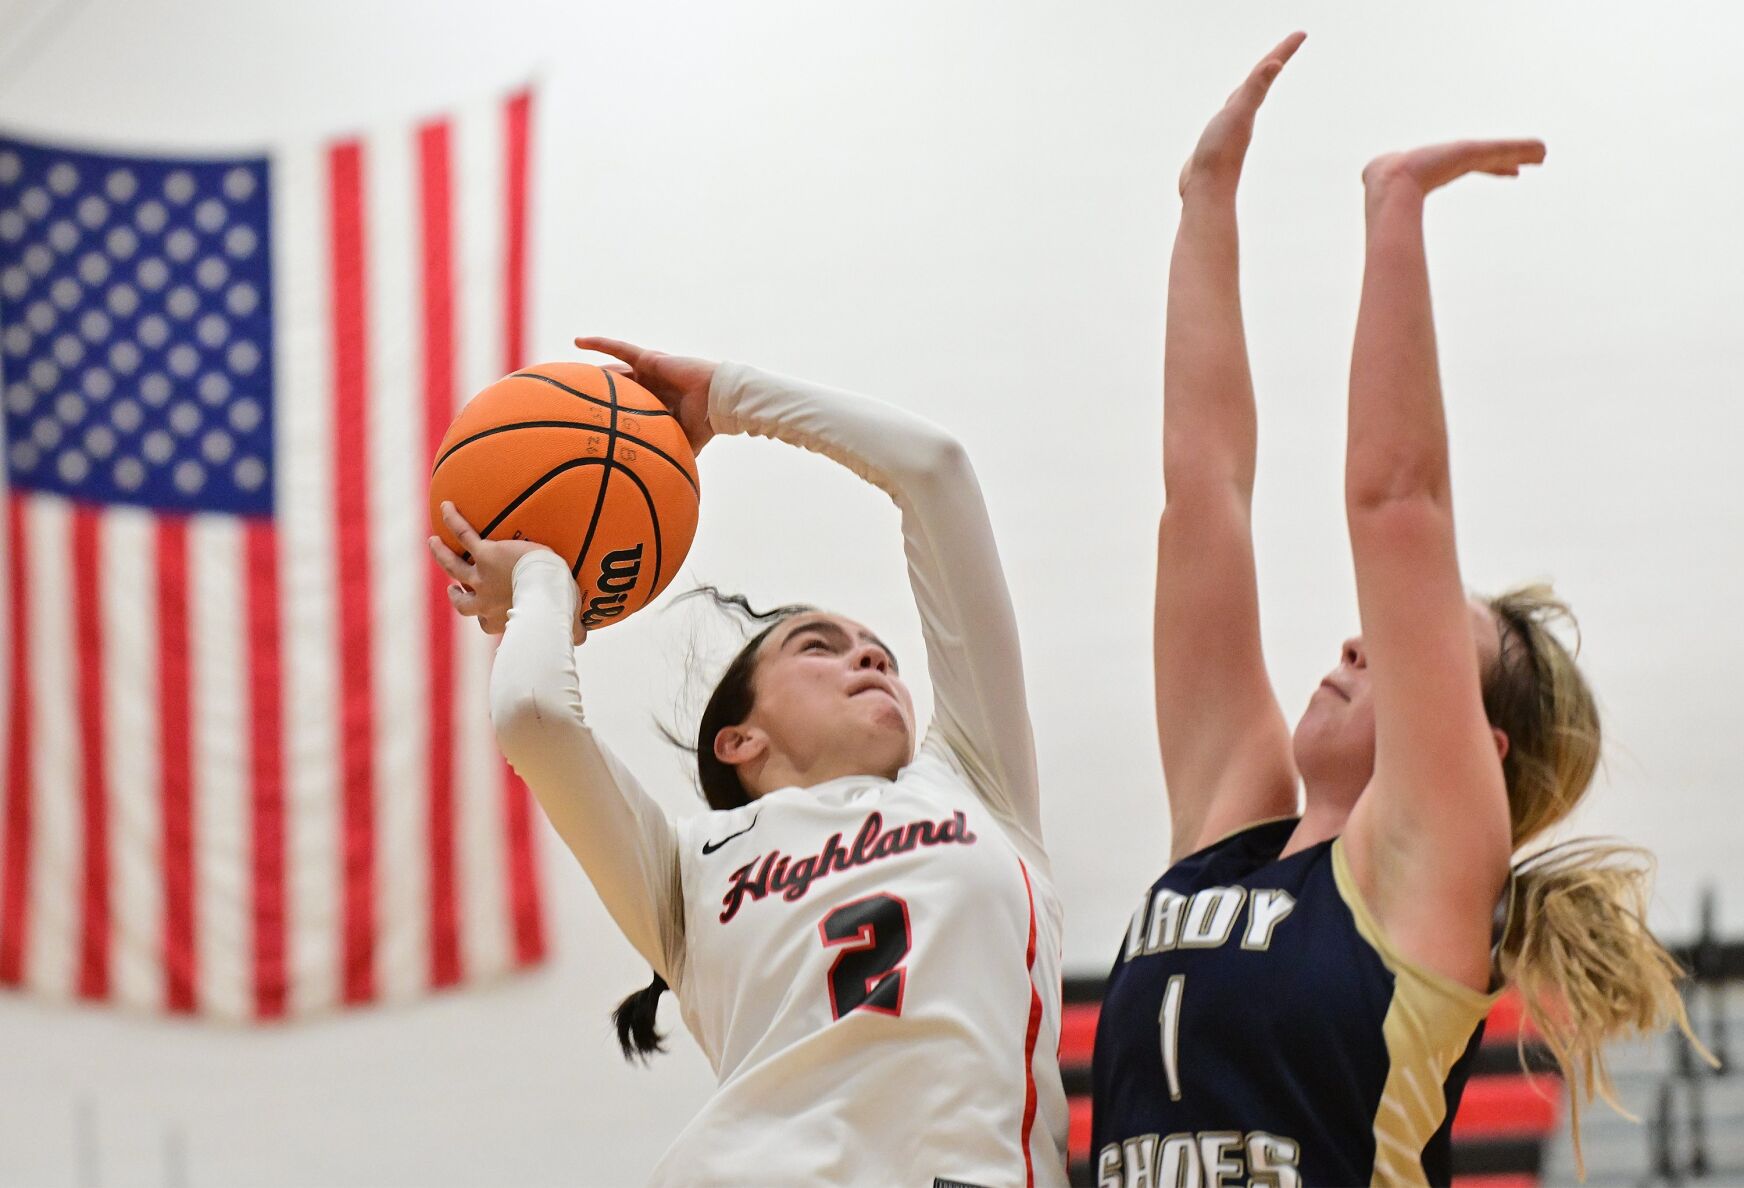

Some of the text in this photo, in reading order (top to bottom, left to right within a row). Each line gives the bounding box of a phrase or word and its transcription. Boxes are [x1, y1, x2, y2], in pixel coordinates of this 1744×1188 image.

[719, 810, 977, 924] Highland
[1124, 885, 1297, 962] LADY
[818, 891, 912, 1022] 2
[1158, 974, 1186, 1102] 1
[1098, 1130, 1302, 1188] SHOES
